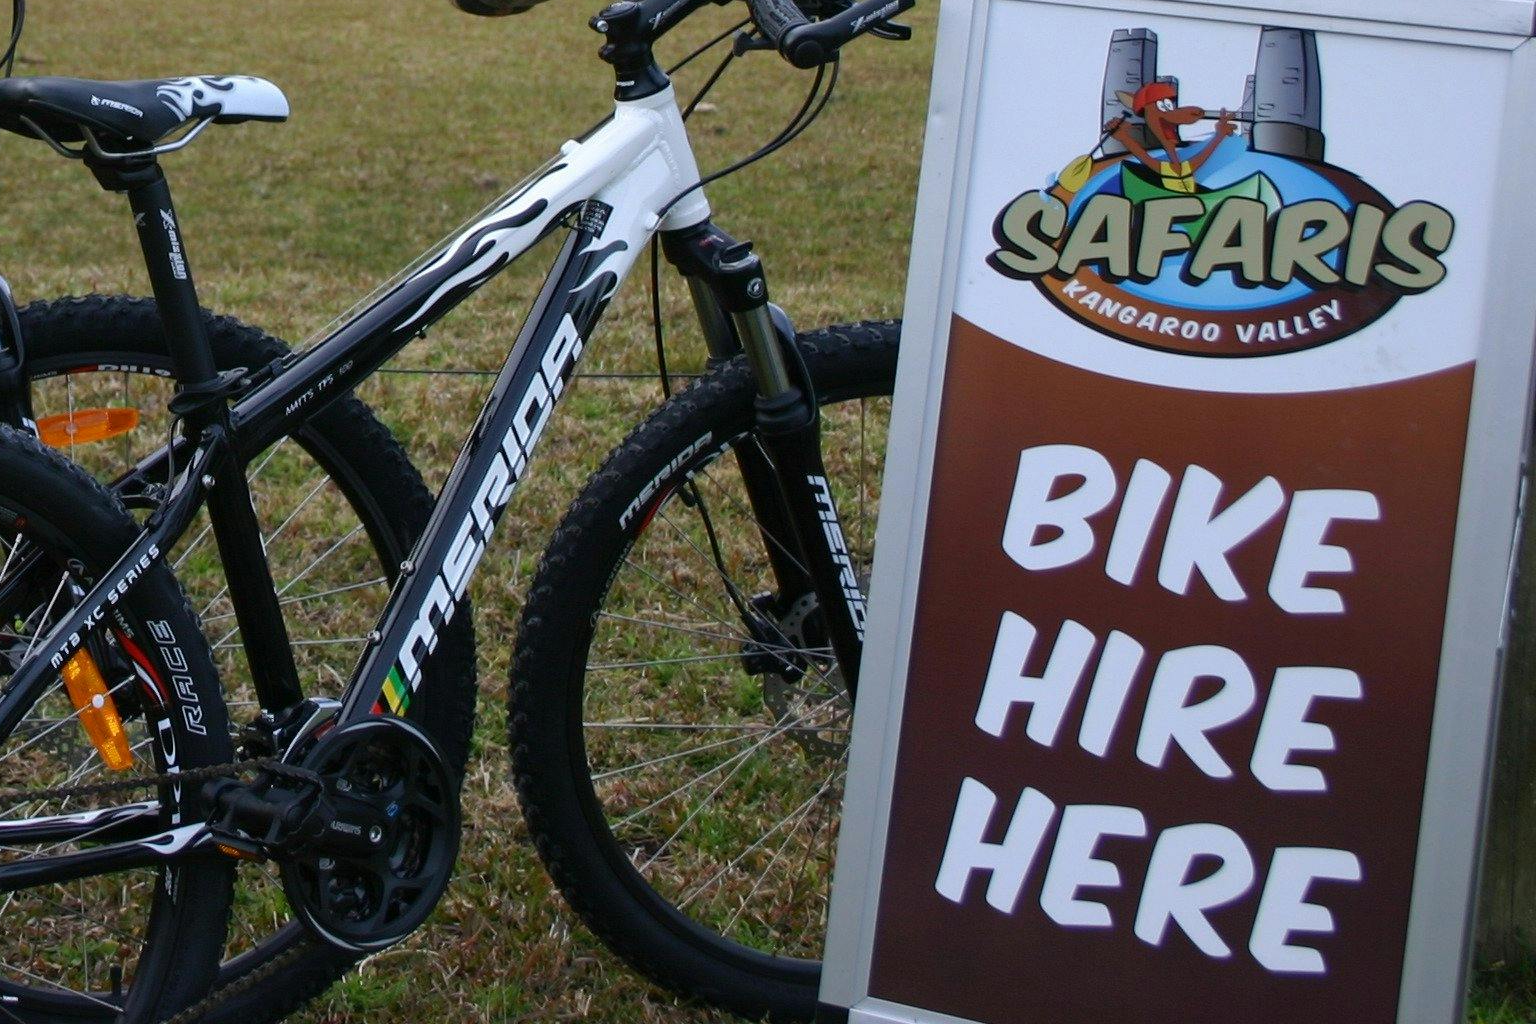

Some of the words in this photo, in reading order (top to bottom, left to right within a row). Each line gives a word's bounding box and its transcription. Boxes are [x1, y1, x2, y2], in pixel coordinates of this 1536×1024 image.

[988, 188, 1456, 294] SAFARIS
[1062, 278, 1221, 343] KANGAROO
[1235, 298, 1343, 344] VALLEY
[398, 312, 584, 693] MERIDA
[619, 430, 713, 531] MERIDA
[1001, 443, 1381, 614] BIKE
[49, 634, 81, 670] MTB
[84, 605, 106, 631] XC
[107, 543, 162, 606] SERIES
[807, 475, 867, 642] MERID
[146, 619, 207, 737] RACE
[974, 609, 1364, 792] HIRE
[934, 776, 1363, 973] HERE
